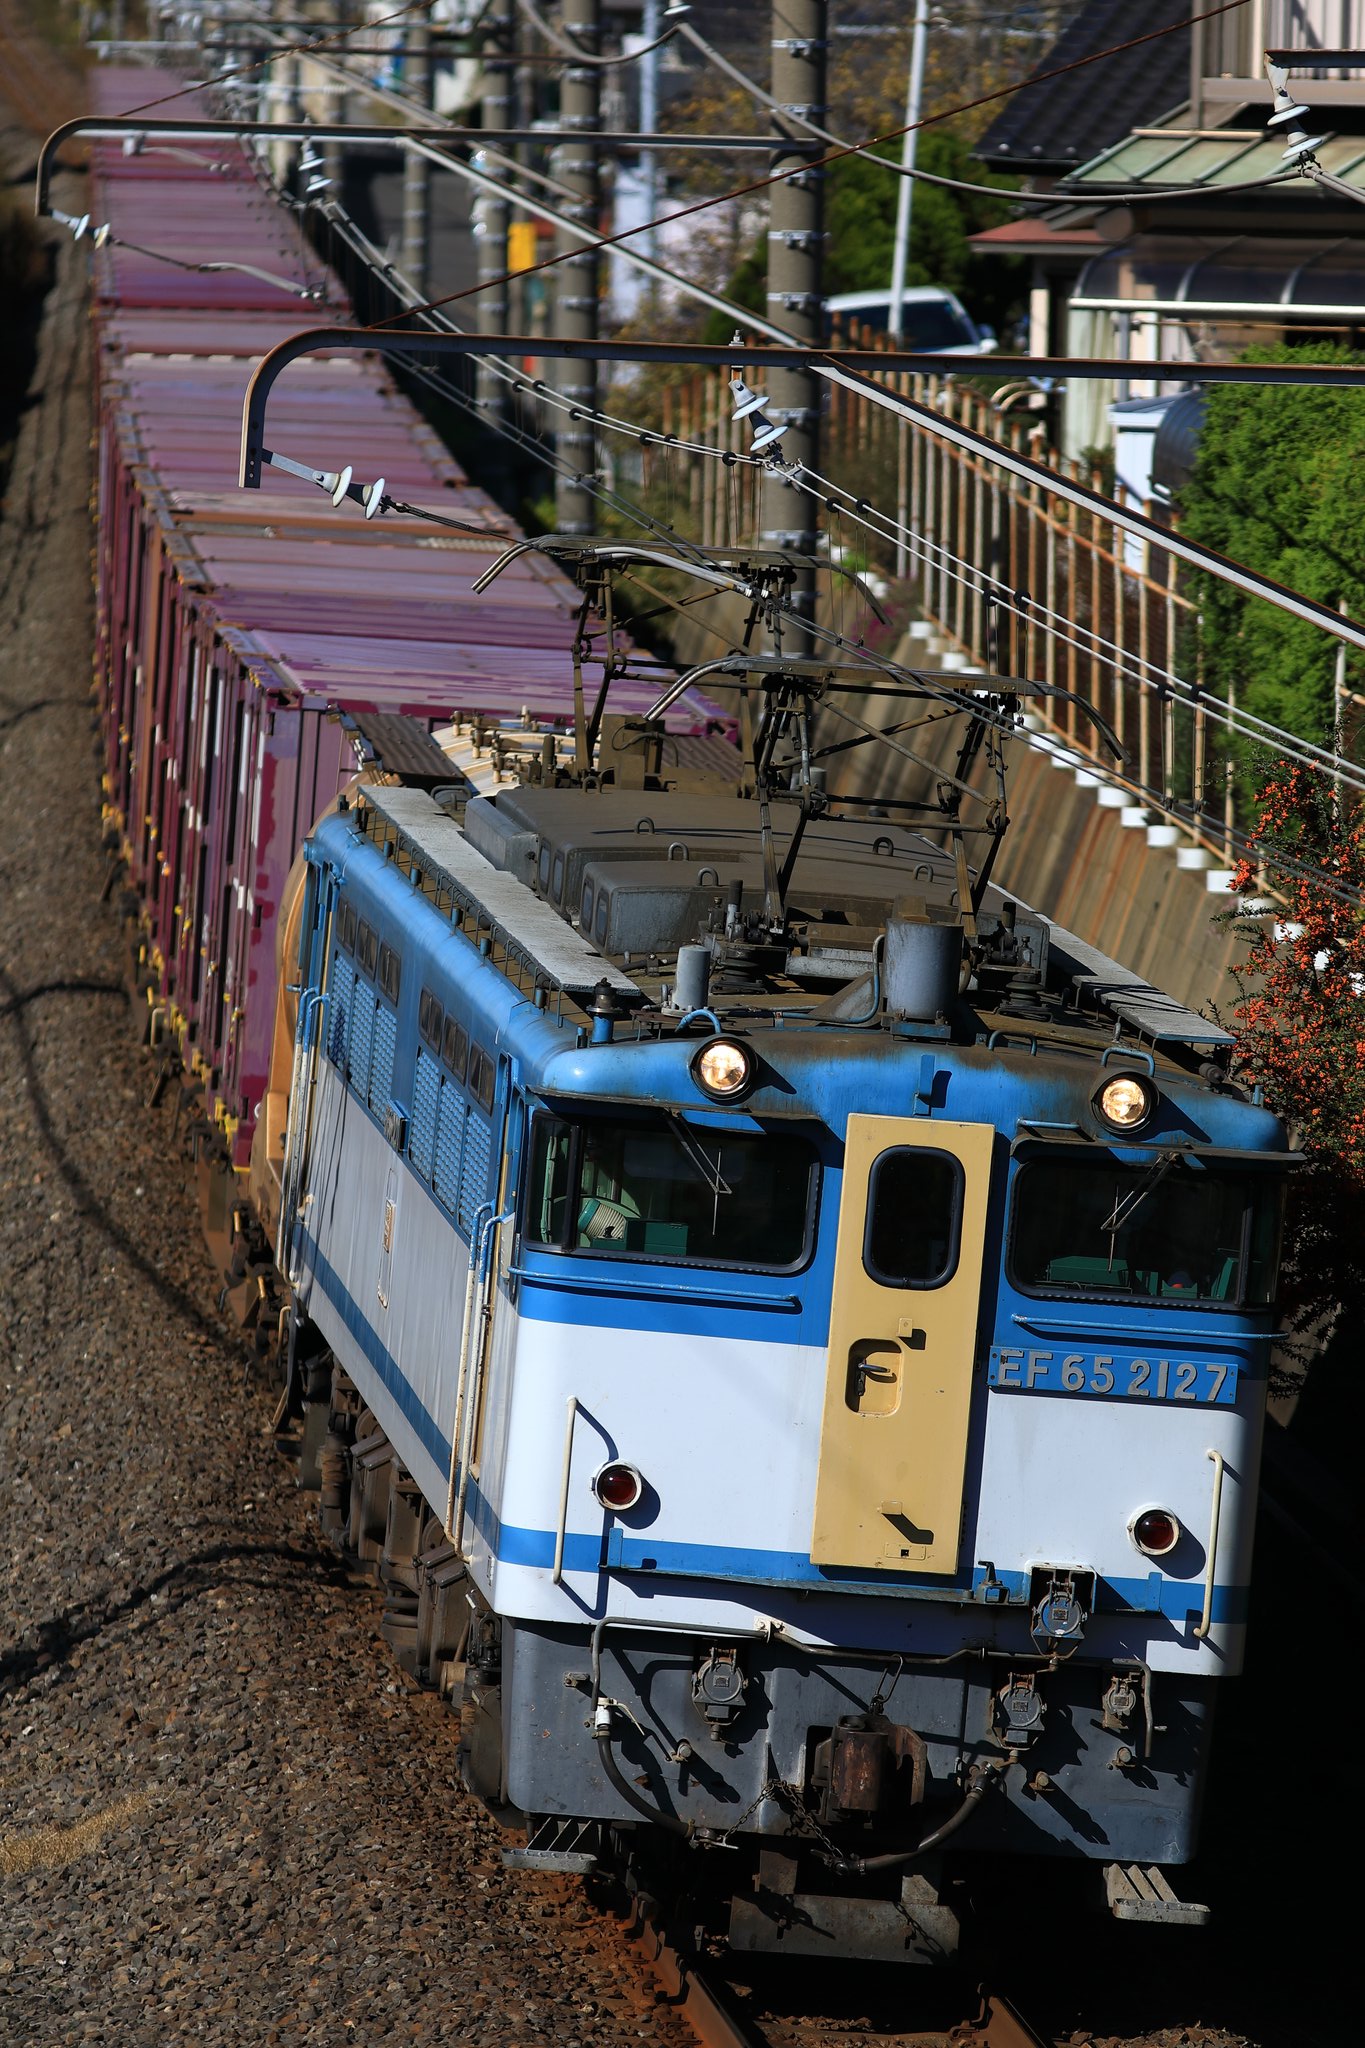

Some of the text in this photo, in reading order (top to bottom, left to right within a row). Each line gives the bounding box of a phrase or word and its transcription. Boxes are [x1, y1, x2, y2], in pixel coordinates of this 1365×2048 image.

[997, 1349, 1228, 1402] EF 65 2127
